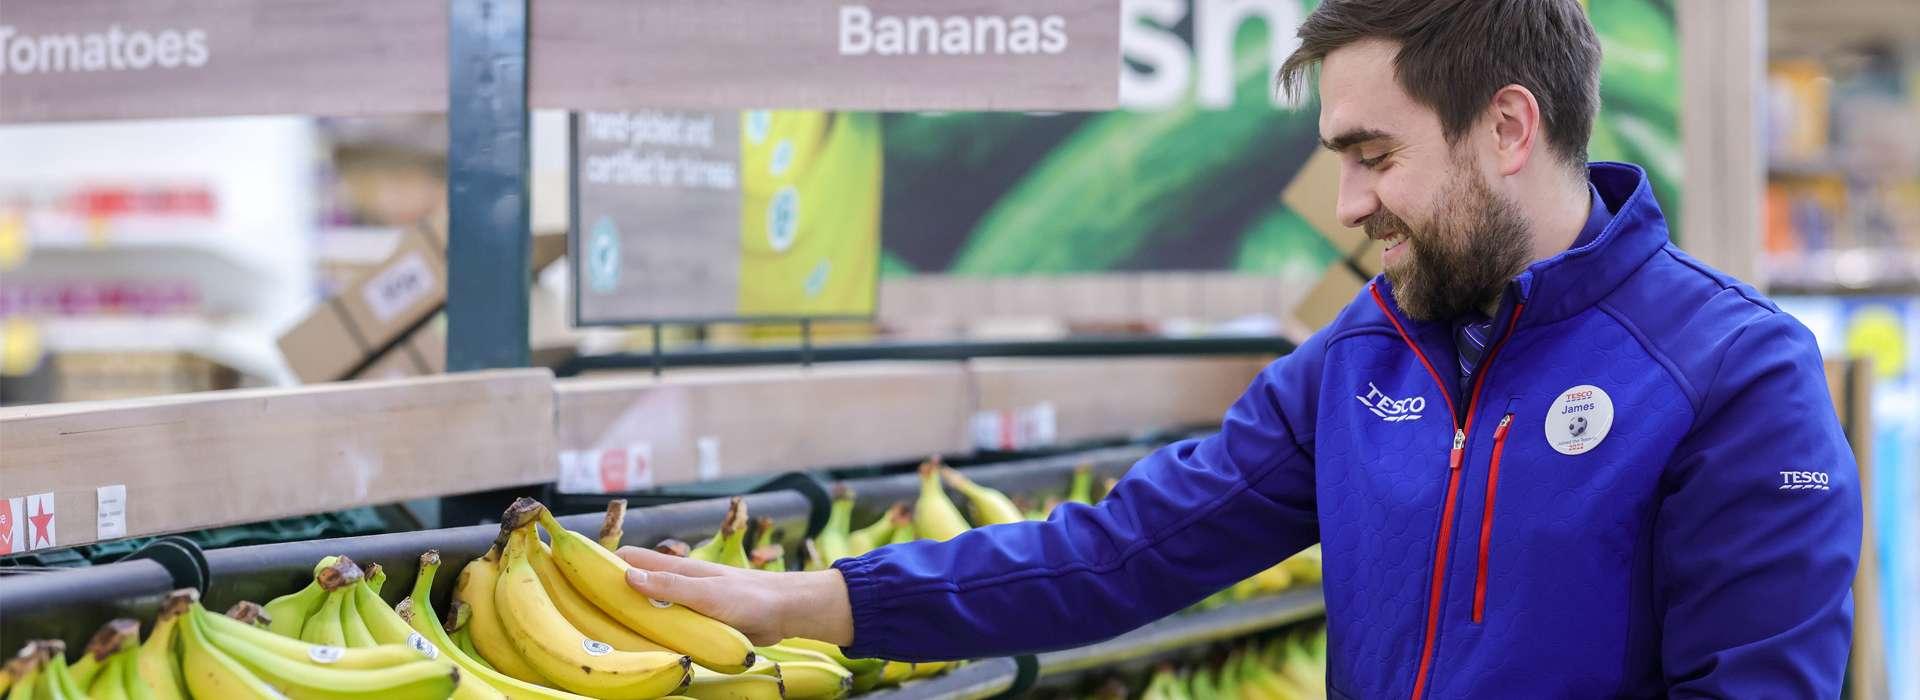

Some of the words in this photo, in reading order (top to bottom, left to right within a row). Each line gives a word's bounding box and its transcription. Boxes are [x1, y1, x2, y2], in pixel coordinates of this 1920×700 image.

[838, 5, 1069, 55] Bananas
[0, 23, 209, 75] Tomatoes
[1366, 381, 1426, 414] TESCO
[1566, 390, 1593, 401] TESCO
[1562, 403, 1594, 414] James
[1779, 471, 1829, 485] TESCO
